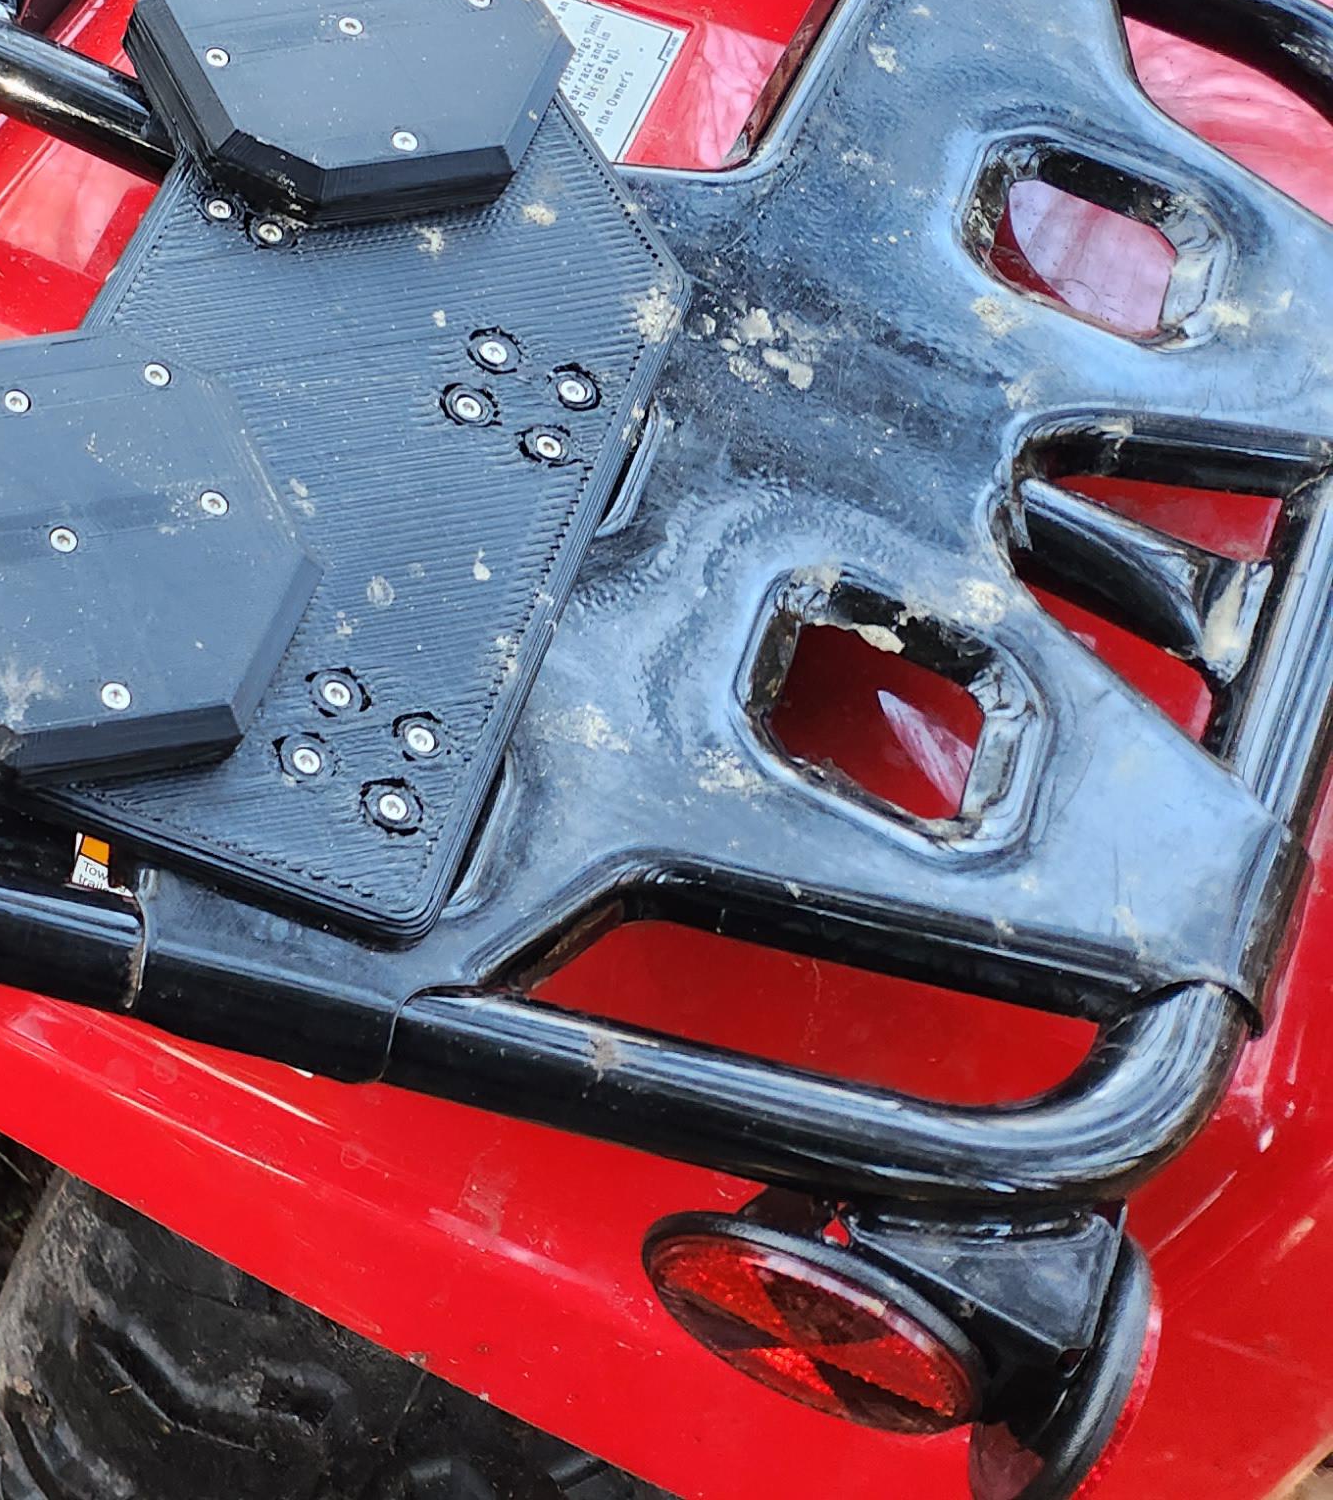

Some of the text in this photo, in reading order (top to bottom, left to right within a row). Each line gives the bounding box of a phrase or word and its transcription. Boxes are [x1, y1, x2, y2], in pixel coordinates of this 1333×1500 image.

[568, 31, 612, 102] ear rack and in
[574, 36, 592, 64] cargo
[584, 14, 604, 36] limit
[583, 86, 599, 101] lbs
[594, 70, 634, 137] in the Owner's
